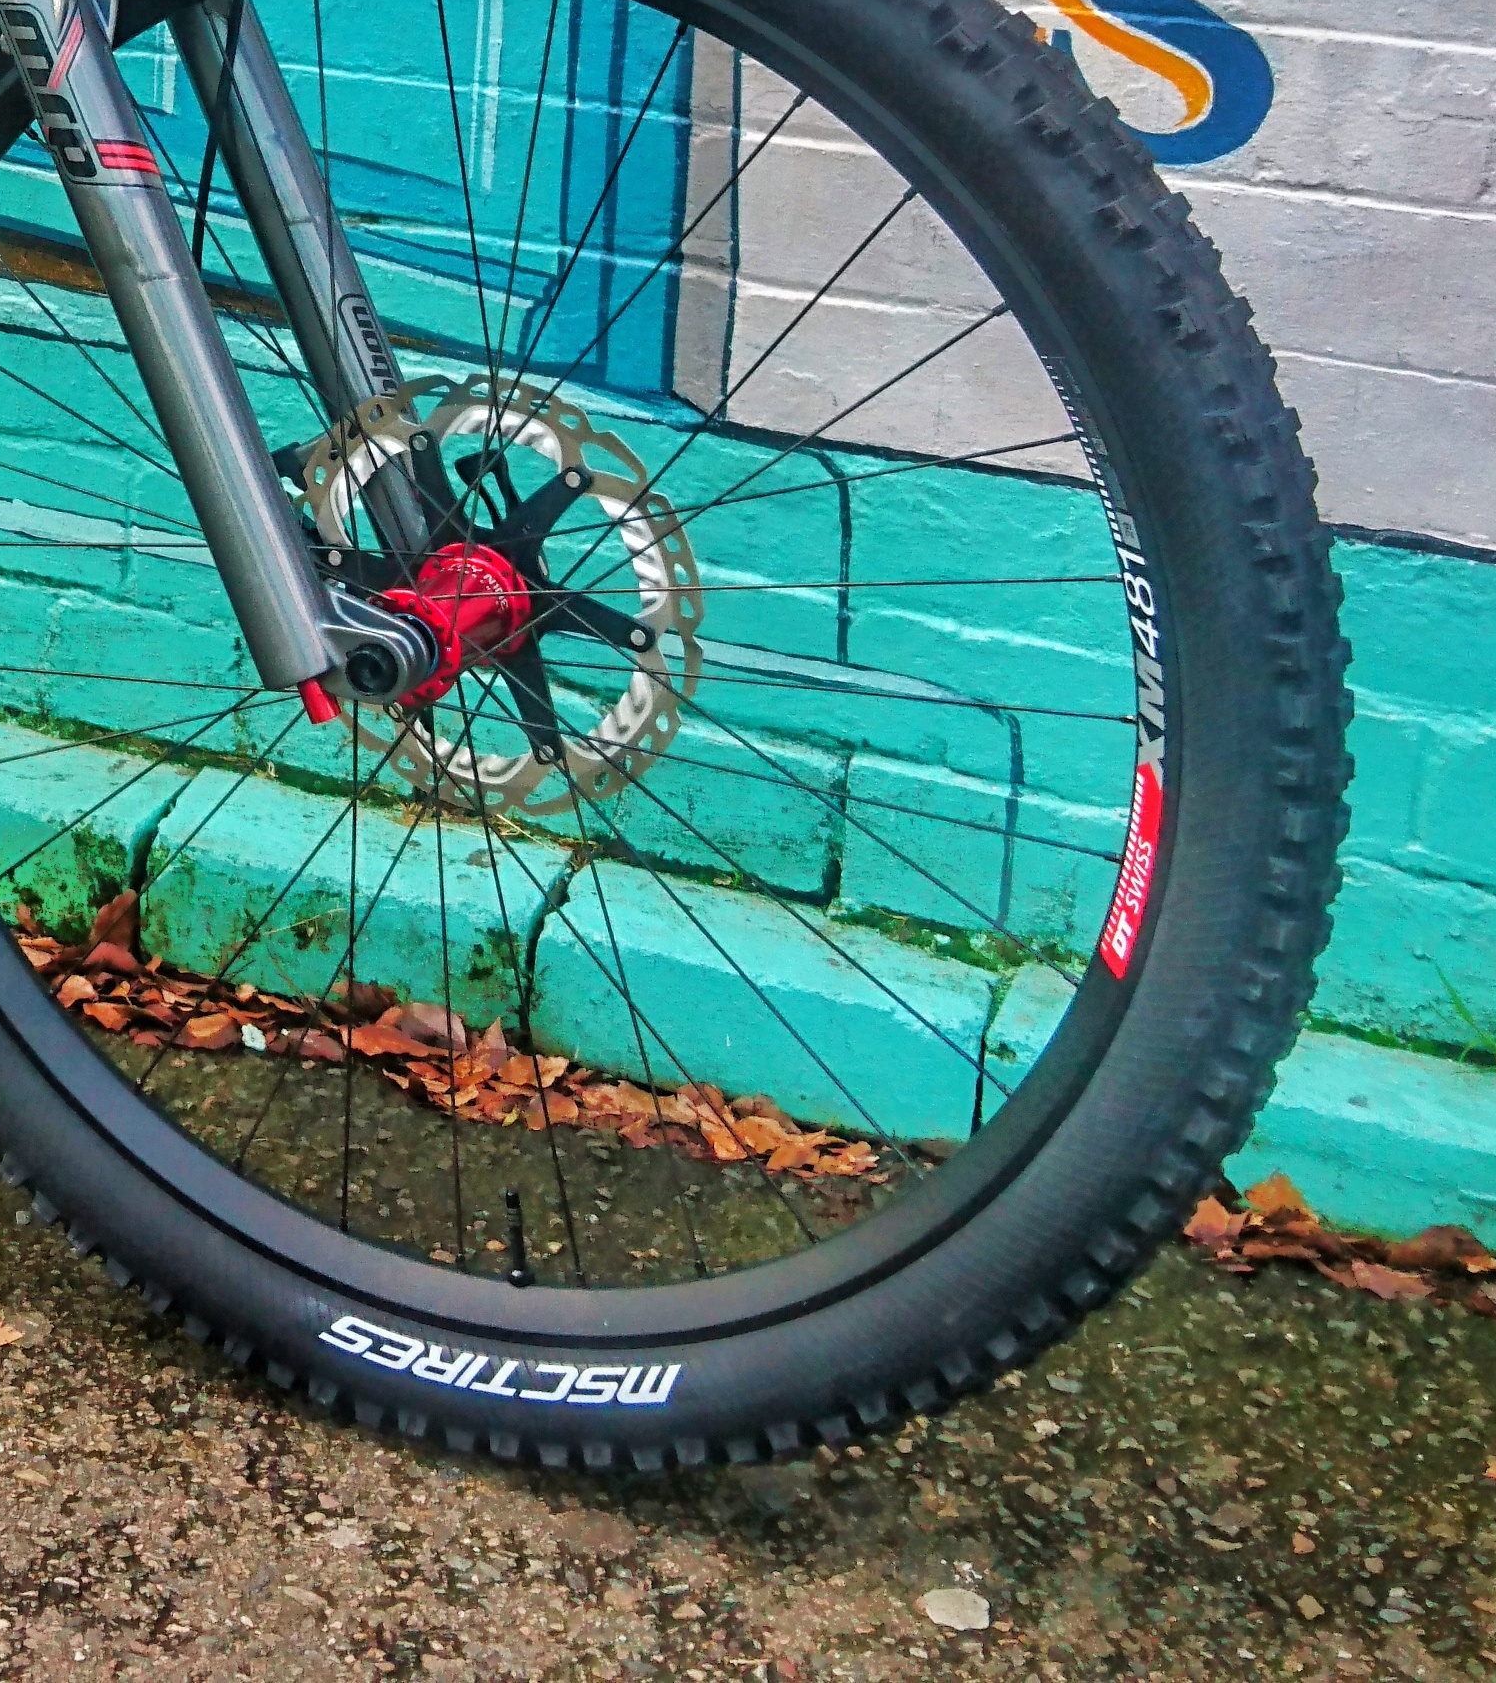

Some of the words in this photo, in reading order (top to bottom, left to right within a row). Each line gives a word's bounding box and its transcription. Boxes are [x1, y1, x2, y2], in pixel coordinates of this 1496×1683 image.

[1120, 548, 1166, 783] XM481
[1124, 836, 1152, 918] SWISS
[1111, 916, 1135, 961] DT
